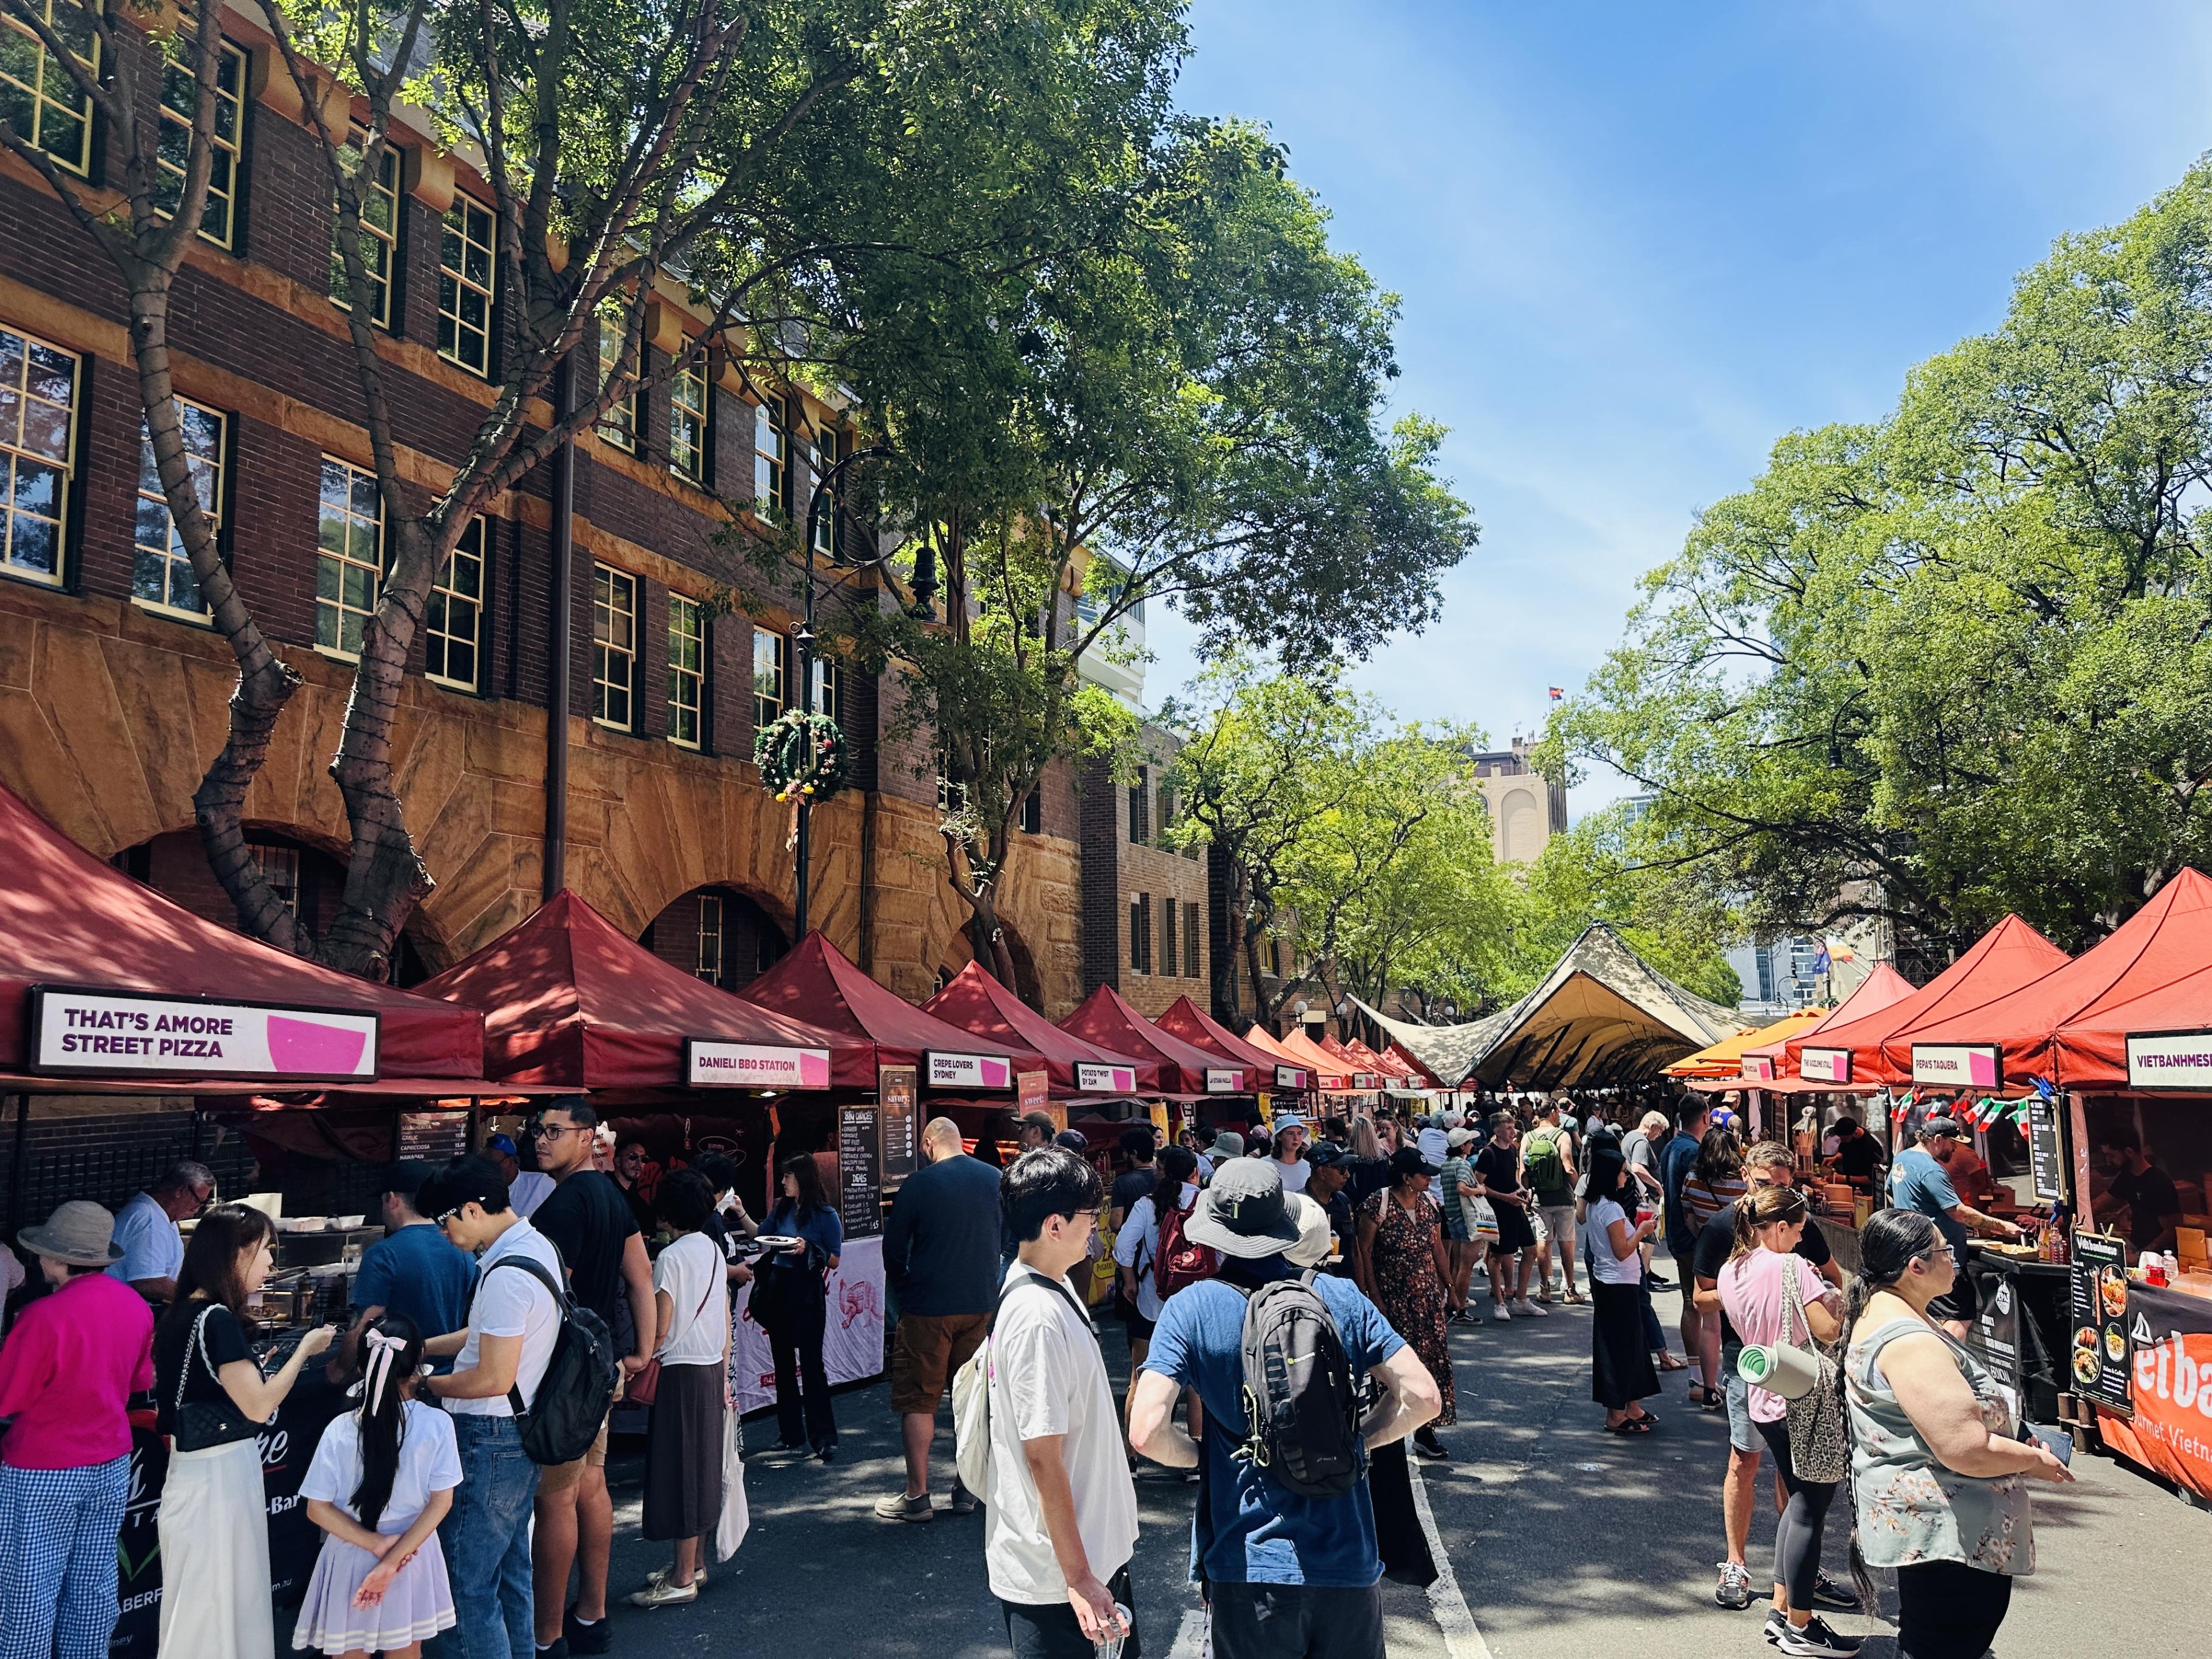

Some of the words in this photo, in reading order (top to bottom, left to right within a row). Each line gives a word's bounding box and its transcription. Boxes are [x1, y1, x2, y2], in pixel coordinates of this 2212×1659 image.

[65, 1008, 149, 1031] THAT'S
[154, 1014, 233, 1035] AMORE
[62, 1033, 154, 1055] STREET
[159, 1038, 223, 1058] PIZZA
[699, 1056, 736, 1069] DANIELI
[738, 1059, 757, 1069] BBQ
[759, 1060, 795, 1071] STATION
[934, 1059, 953, 1067] CREPE
[953, 1060, 973, 1069] LOVERS
[1916, 1059, 1931, 1069] PEPA'S
[1933, 1060, 1958, 1070] TAQUERA
[934, 1070, 956, 1079] SYDNEY
[852, 1174, 867, 1183] DEALS
[1096, 1262, 1112, 1272] Potato
[2169, 1425, 2212, 1464] Vietn
